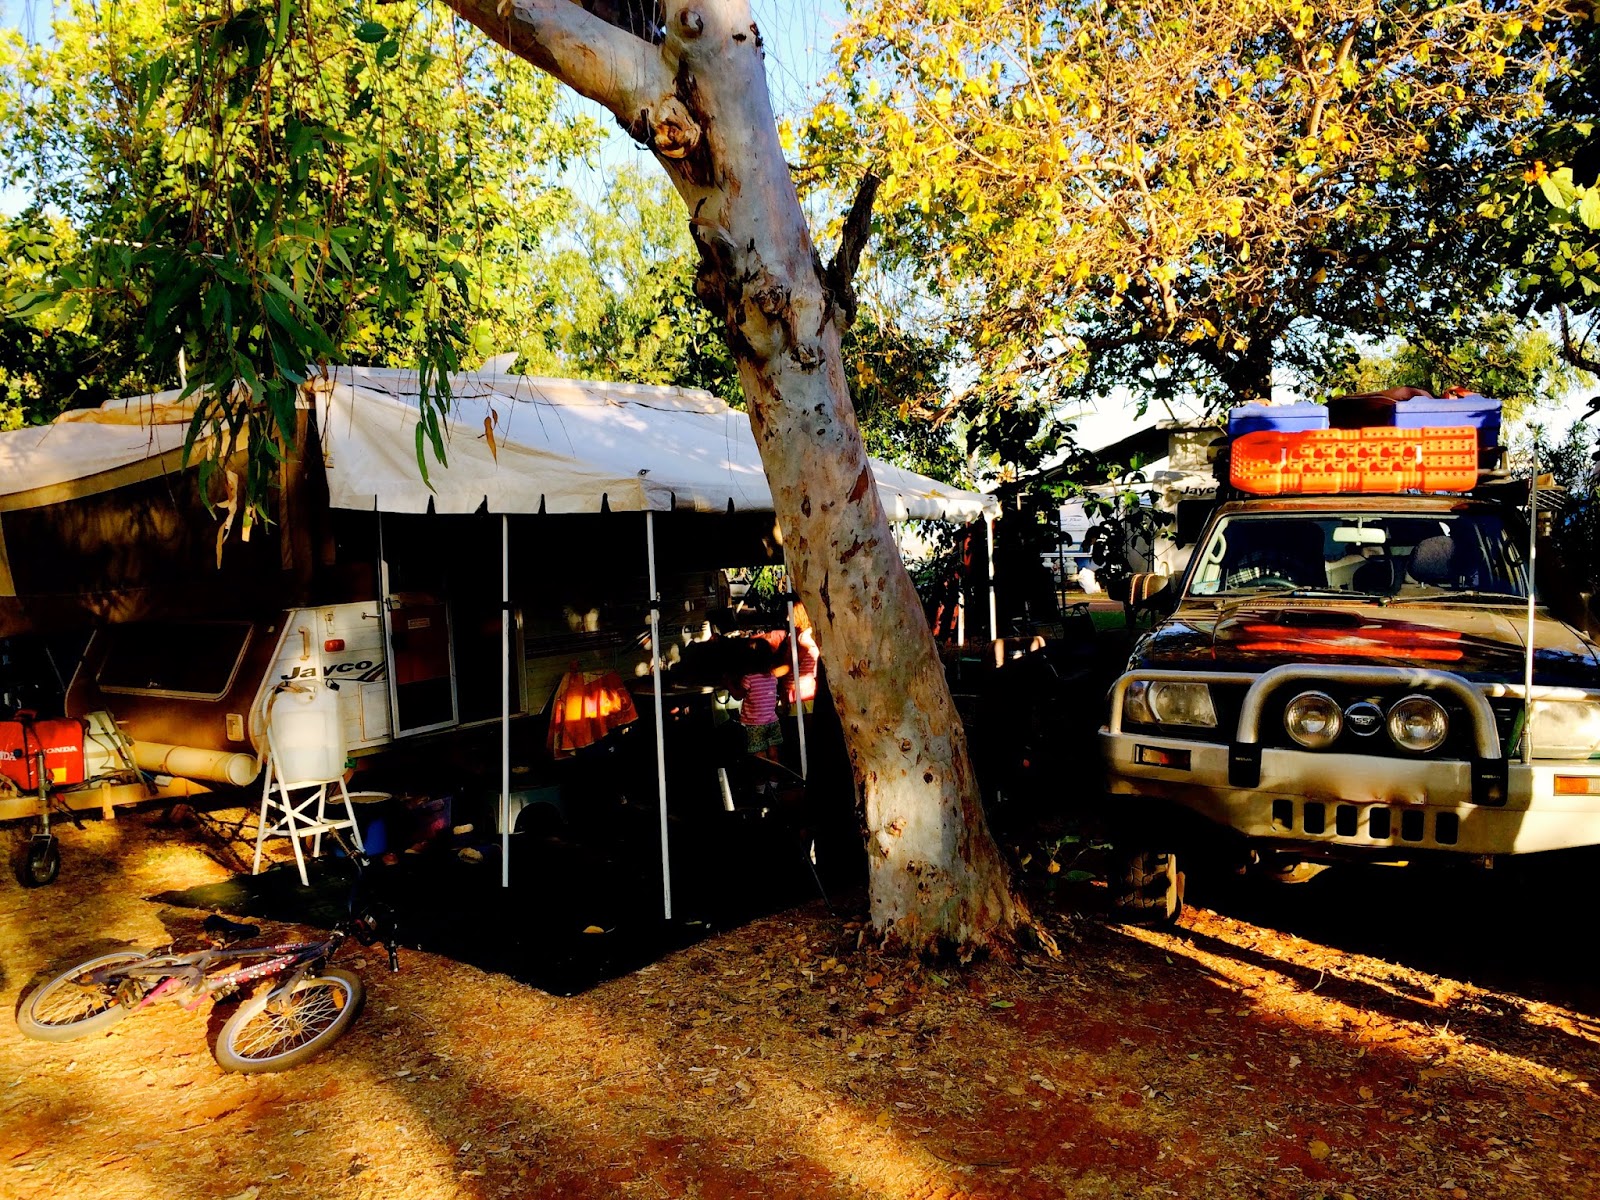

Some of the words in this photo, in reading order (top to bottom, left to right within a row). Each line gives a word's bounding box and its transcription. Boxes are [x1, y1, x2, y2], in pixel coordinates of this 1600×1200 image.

[1181, 486, 1216, 496] Jayc
[280, 660, 373, 680] Jayco
[43, 745, 78, 754] ONDA
